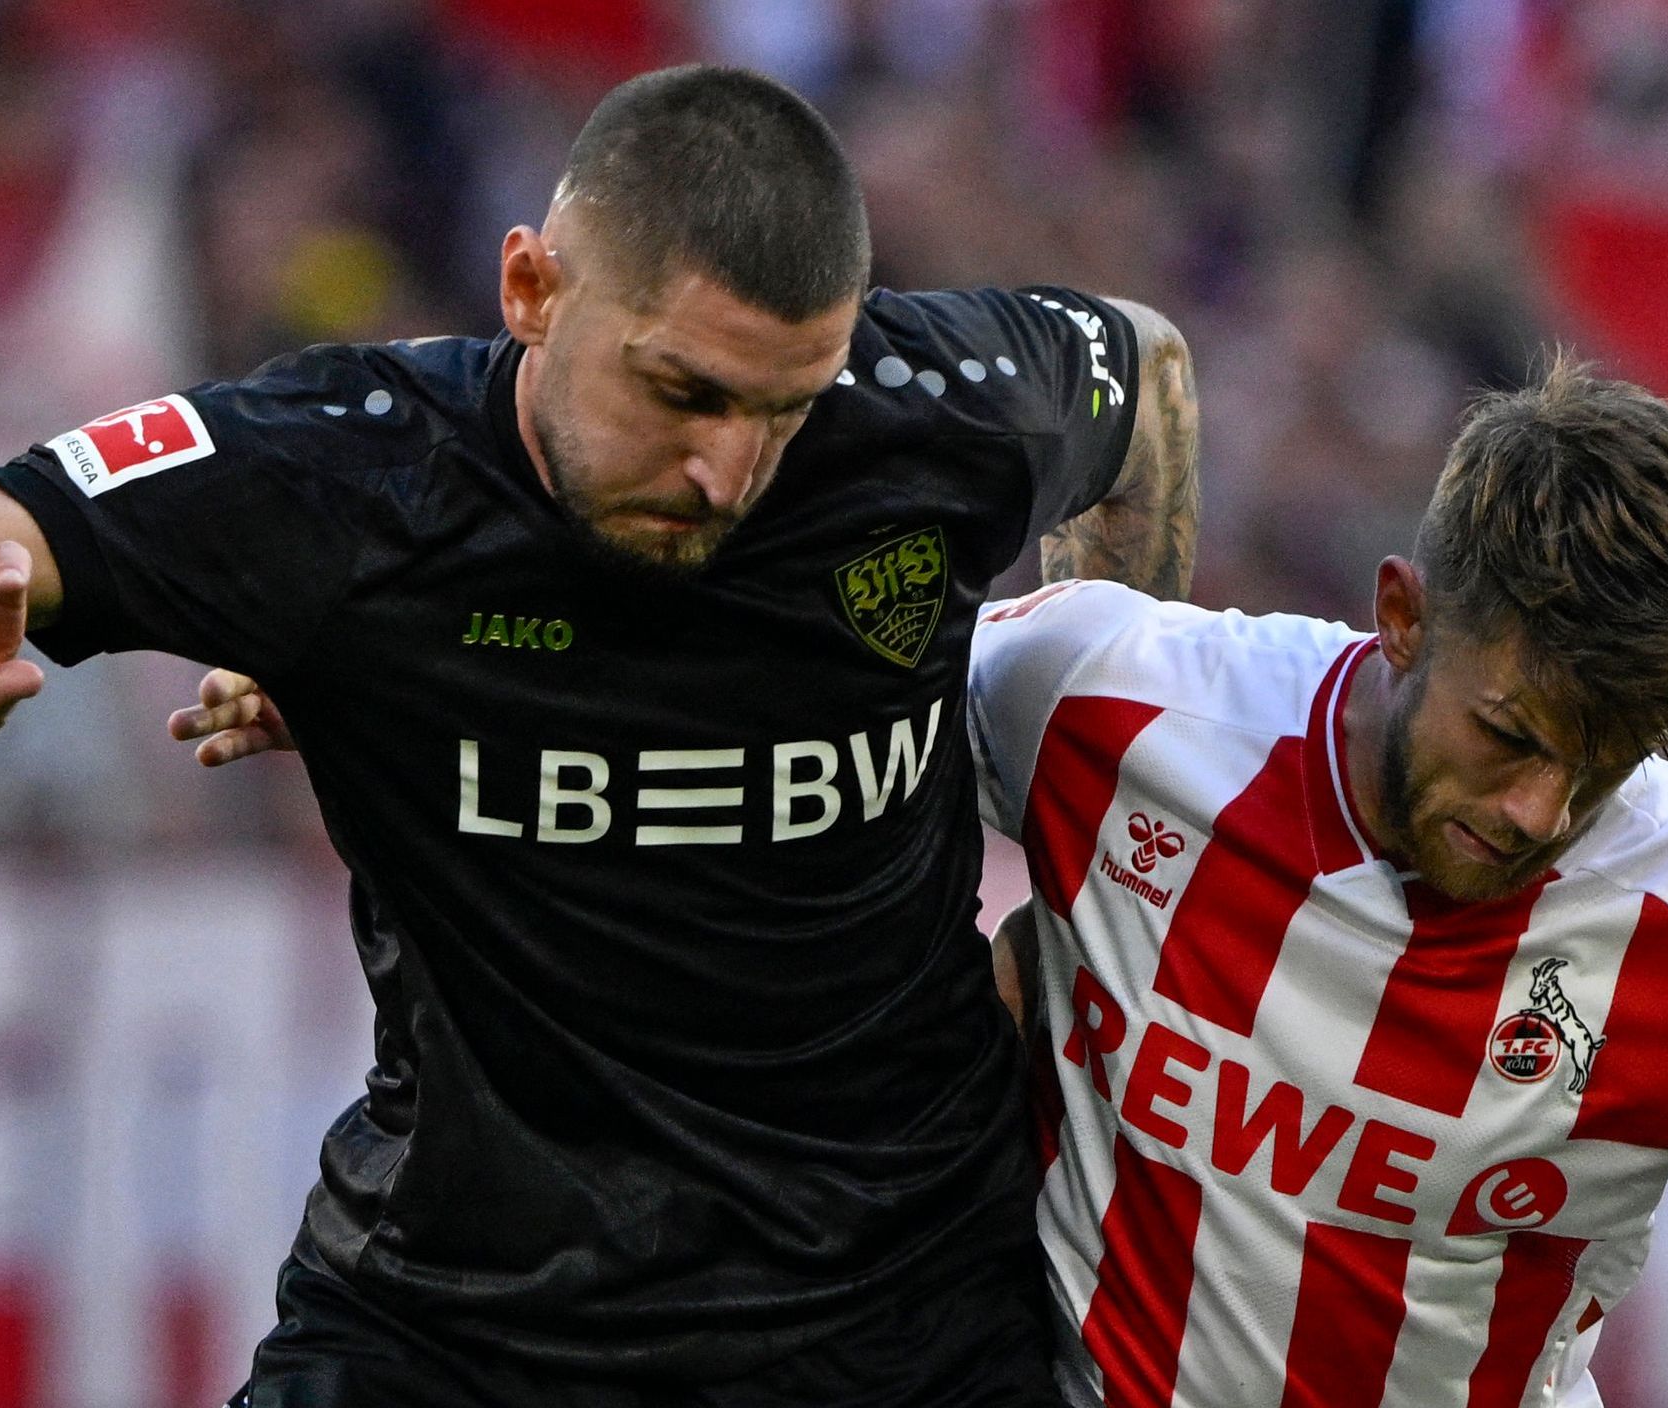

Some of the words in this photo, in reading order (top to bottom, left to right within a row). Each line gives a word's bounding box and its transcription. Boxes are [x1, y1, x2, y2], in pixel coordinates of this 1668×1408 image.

[462, 612, 574, 652] JAKO
[1099, 850, 1173, 910] hummel
[1062, 964, 1437, 1226] REWE
